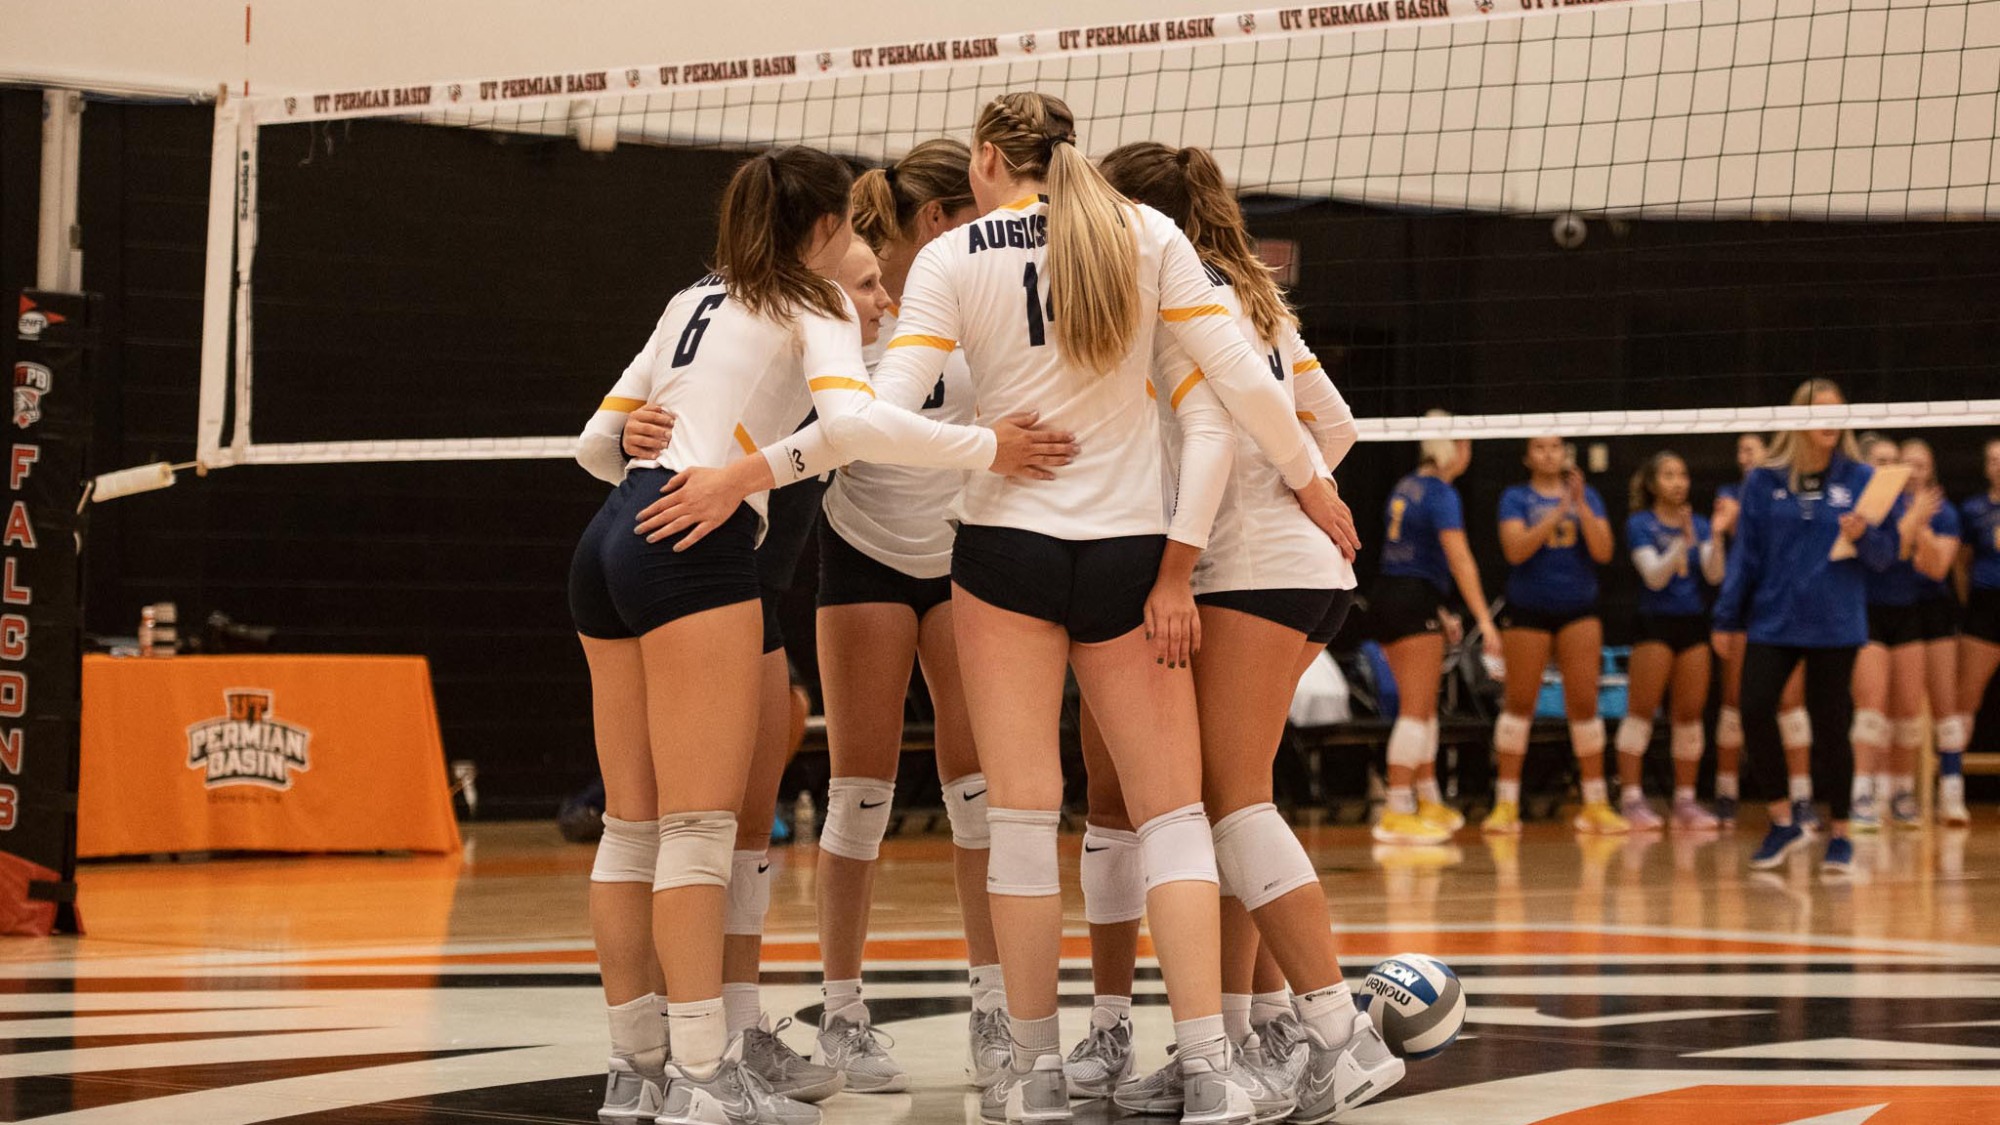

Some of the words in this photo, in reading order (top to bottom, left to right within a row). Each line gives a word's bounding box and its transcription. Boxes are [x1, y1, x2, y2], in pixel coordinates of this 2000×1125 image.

[1279, 9, 1302, 30] UT
[1308, 1, 1390, 28] PERMIAN
[1396, 0, 1450, 20] BASIN
[1058, 30, 1080, 50] UT
[1086, 22, 1160, 48] PERMIAN
[1165, 17, 1215, 41] BASIN
[852, 48, 873, 68] UT
[878, 41, 947, 67] PERMIAN
[952, 37, 999, 60] BASIN
[479, 81, 498, 100] UT
[501, 75, 562, 99] PERMIAN
[566, 72, 607, 93] BASIN
[659, 66, 679, 86] UT
[683, 59, 748, 84] PERMIAN
[753, 55, 797, 77] BASIN
[313, 94, 330, 113] UT
[334, 89, 390, 113] PERMIAN
[393, 86, 431, 107] BASIN
[671, 292, 728, 369] 6
[228, 694, 270, 721] UT
[190, 720, 308, 766] PERMIAN
[206, 749, 288, 784] BASIN
[1366, 976, 1412, 1006] molten
